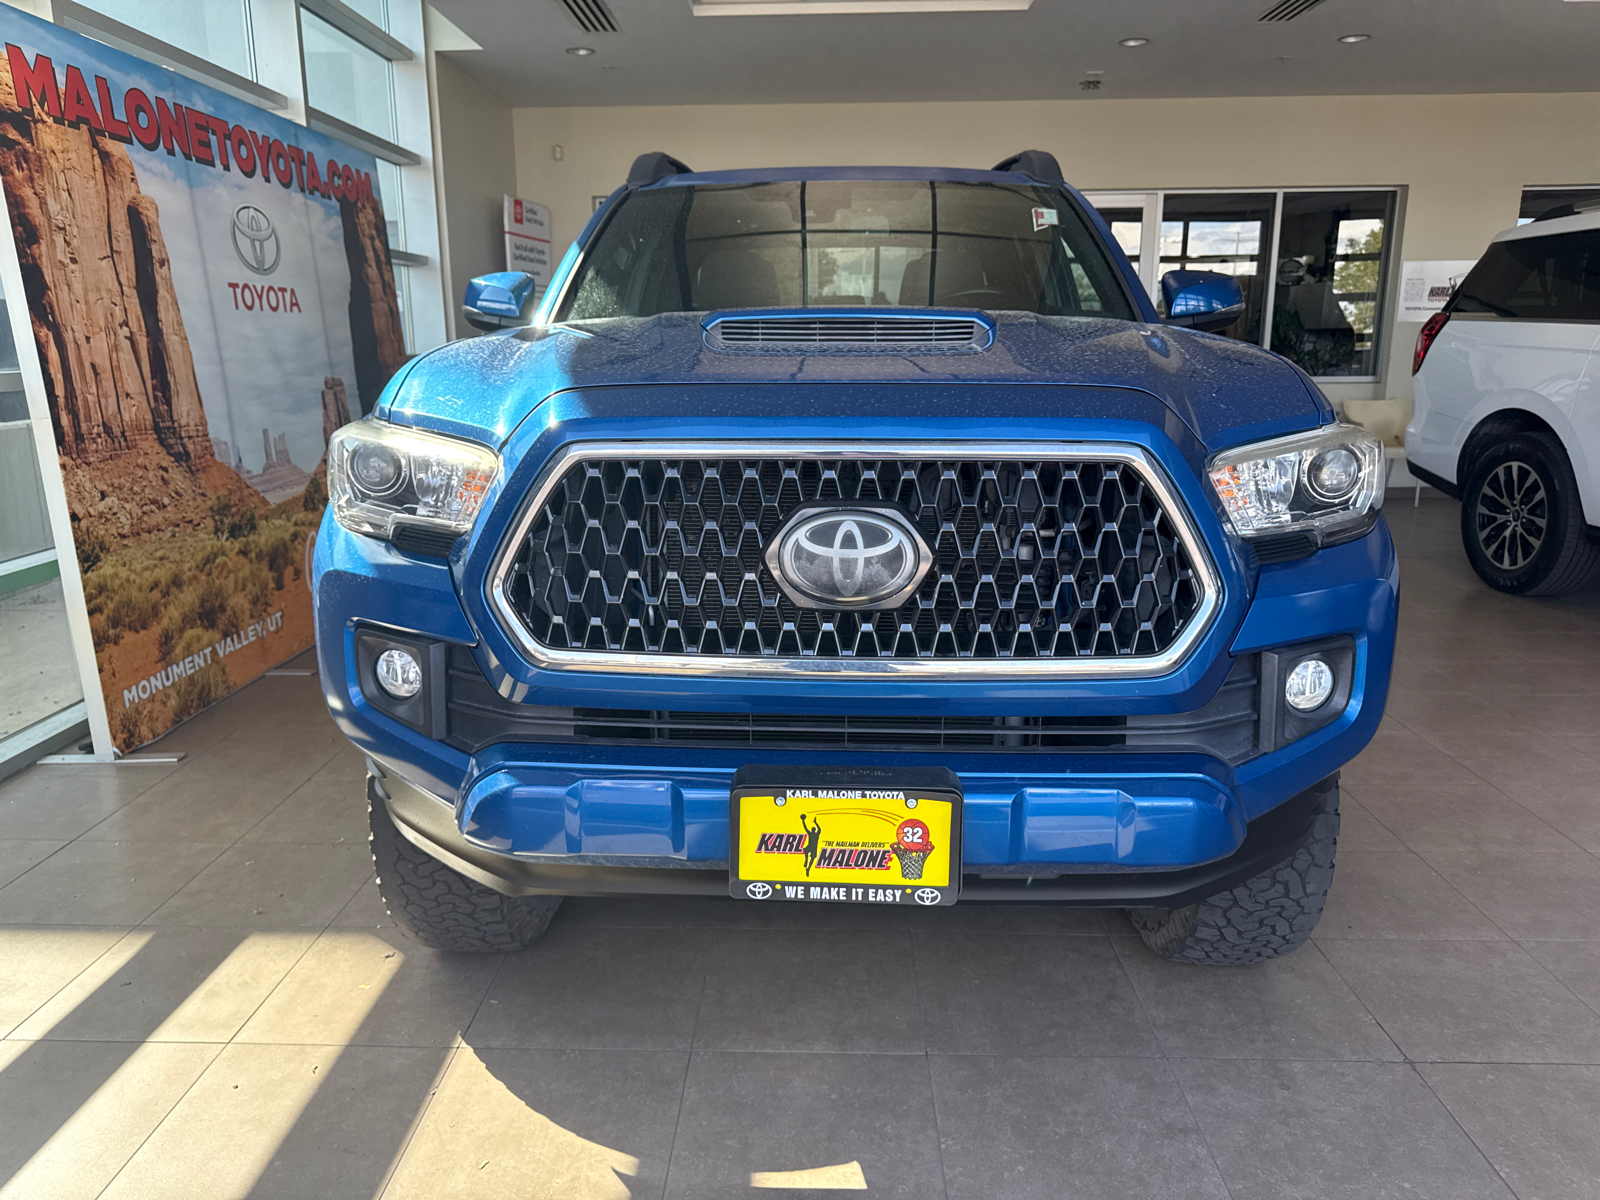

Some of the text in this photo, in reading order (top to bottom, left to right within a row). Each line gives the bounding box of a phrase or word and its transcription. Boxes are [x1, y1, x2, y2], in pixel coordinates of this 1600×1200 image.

[5, 43, 376, 201] MALONETOYOTA.COM
[227, 281, 301, 313] TOYOTA
[122, 611, 283, 709] MONUMENT VALLEY, UT
[786, 789, 906, 801] KARL MALONE TOYOTA
[755, 832, 806, 854] KARL
[902, 827, 923, 844] 32
[815, 848, 894, 871] MALONE
[784, 886, 902, 902] WE MAKE IT EASY
